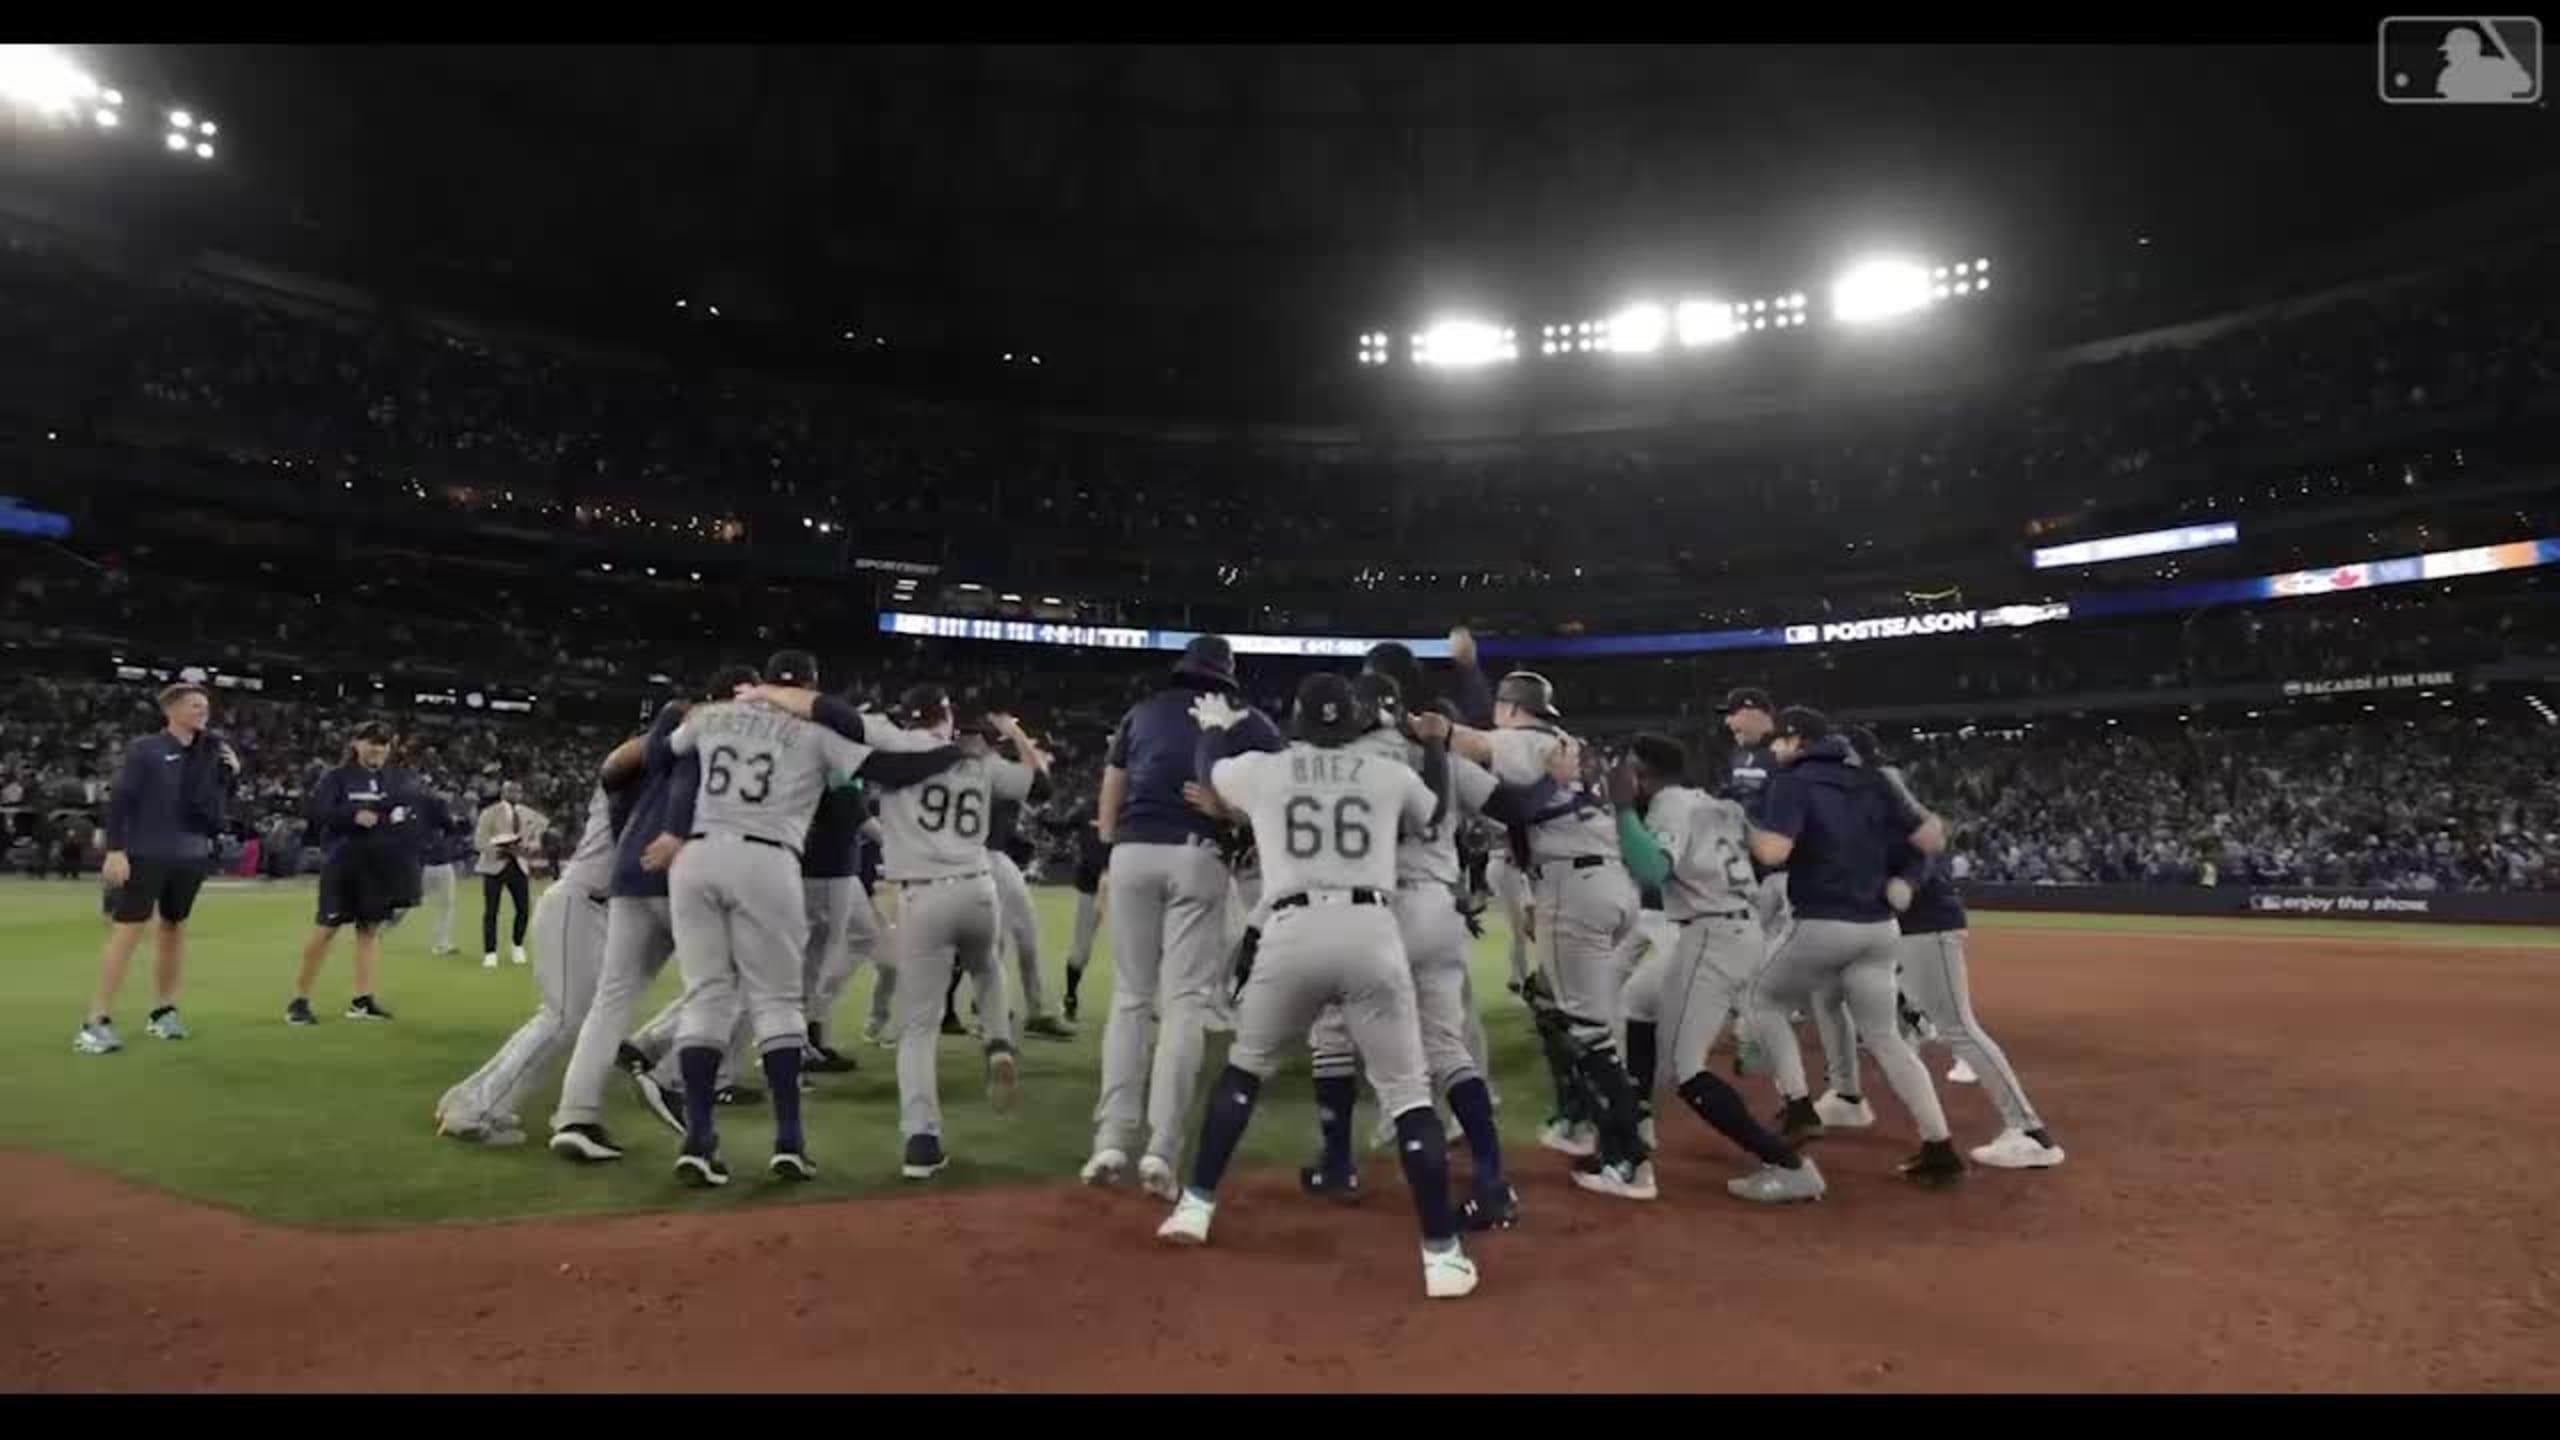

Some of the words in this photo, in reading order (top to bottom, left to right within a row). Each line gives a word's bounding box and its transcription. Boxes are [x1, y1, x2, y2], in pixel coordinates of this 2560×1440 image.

[1823, 611, 1978, 641] POSTSEASON
[705, 745, 776, 804] 63
[917, 784, 983, 838] 96
[1285, 796, 1371, 860] 66
[2282, 895, 2334, 912] enjoy
[2337, 895, 2370, 910] the
